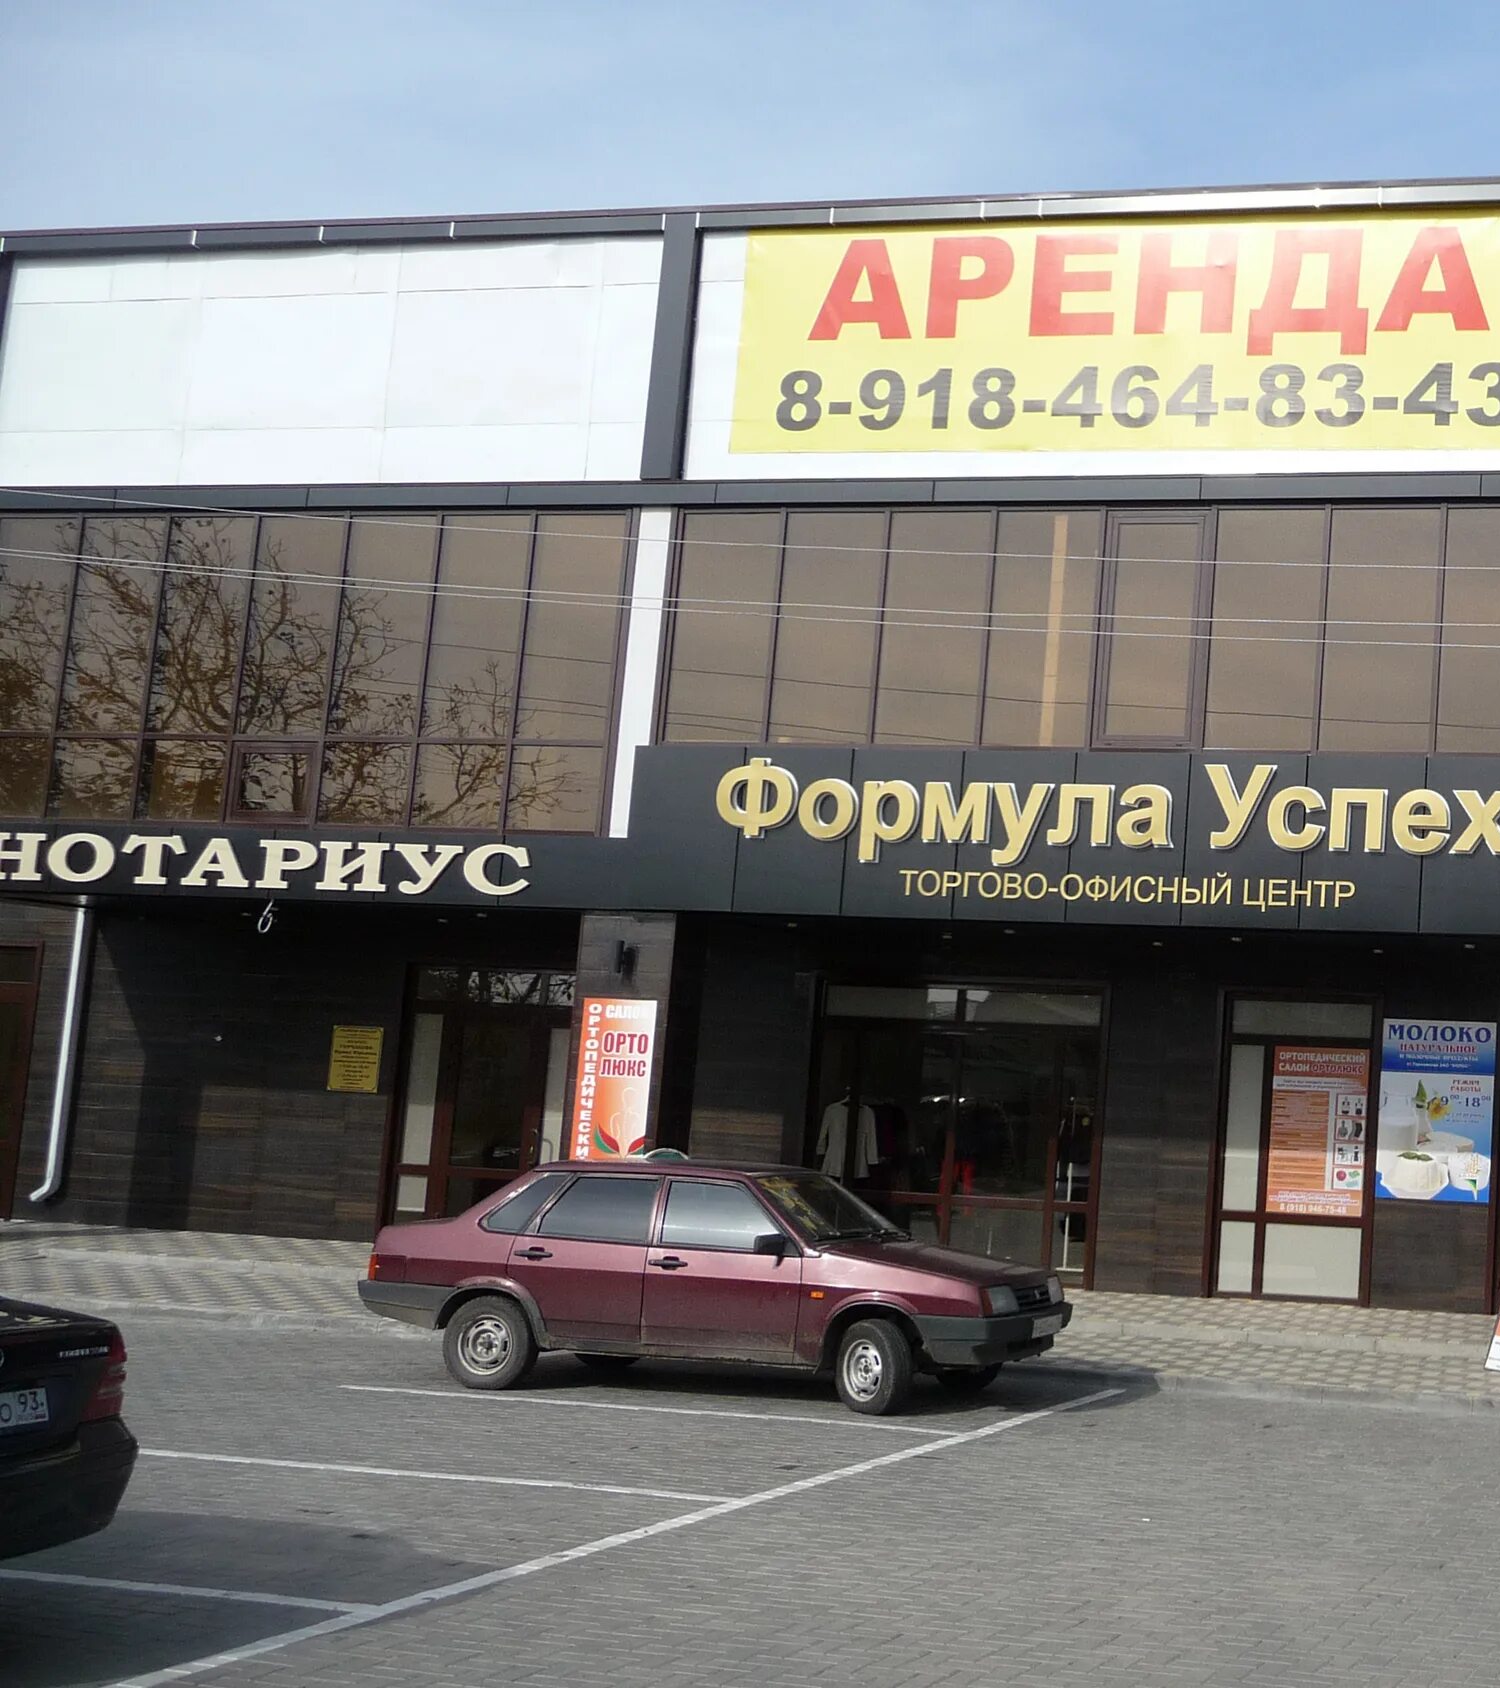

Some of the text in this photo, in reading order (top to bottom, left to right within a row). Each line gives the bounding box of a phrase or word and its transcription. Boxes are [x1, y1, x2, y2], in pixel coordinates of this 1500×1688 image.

[808, 227, 1490, 356] АРЕНДА
[715, 758, 1173, 867] Формула
[0, 832, 531, 895] НОТАРИУС
[900, 868, 1355, 912] ТОРГОВО-ОФИСНЫЙ ЦЕНТР
[605, 1004, 650, 1020] САЛО
[603, 1032, 649, 1054] ОРТО
[1388, 1024, 1491, 1043] МОЛОКО
[1279, 1051, 1366, 1064] ОРТОПЕДИЧЕСКИЙ
[1400, 1044, 1477, 1054] НАТУРАЛЬНОЕ
[600, 1058, 647, 1077] ЛЮКС
[1279, 1063, 1364, 1074] САЛОН ОРТОЛЮКС
[575, 1003, 602, 1159] ОРТОПЕДИЧЕСКИ
[18, 1391, 39, 1412] 93
